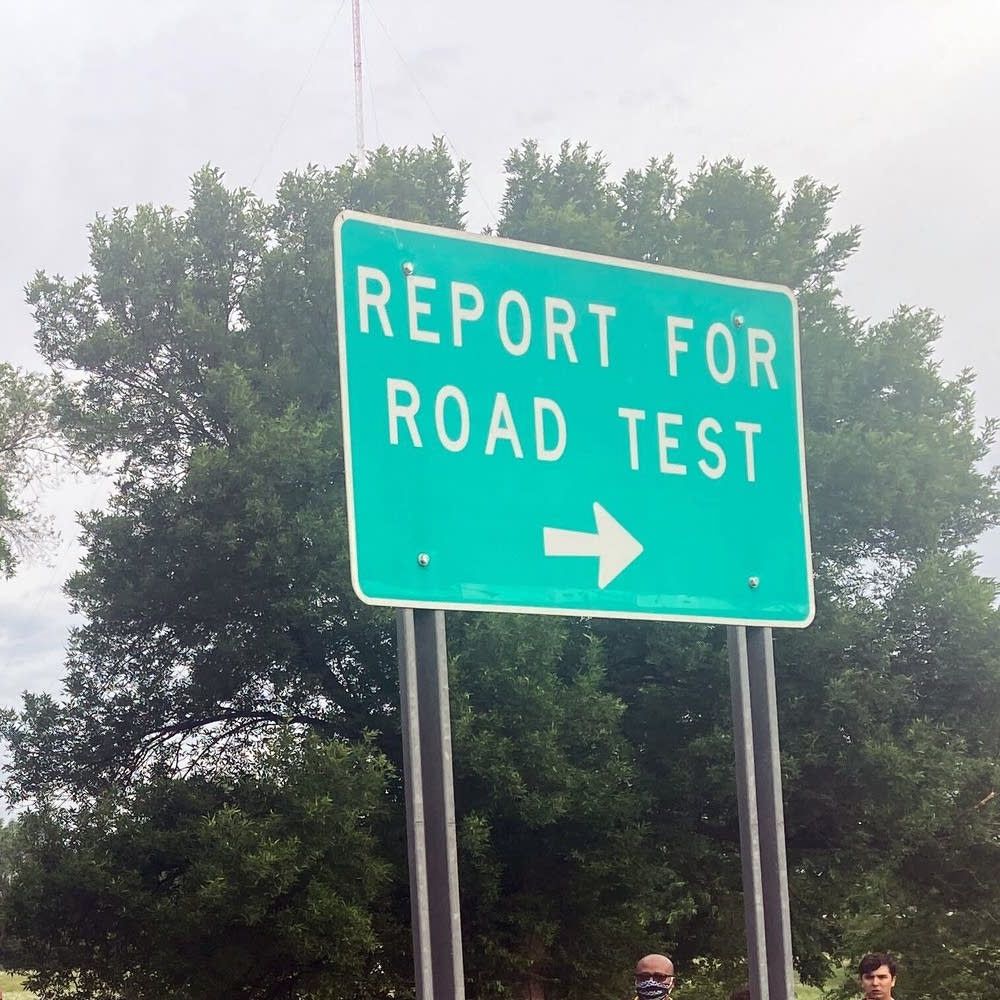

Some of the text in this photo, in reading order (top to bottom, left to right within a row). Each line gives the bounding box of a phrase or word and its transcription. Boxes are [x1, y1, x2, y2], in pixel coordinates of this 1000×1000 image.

[357, 265, 778, 389] REPORT FOR
[387, 378, 762, 482] ROAD TEST
